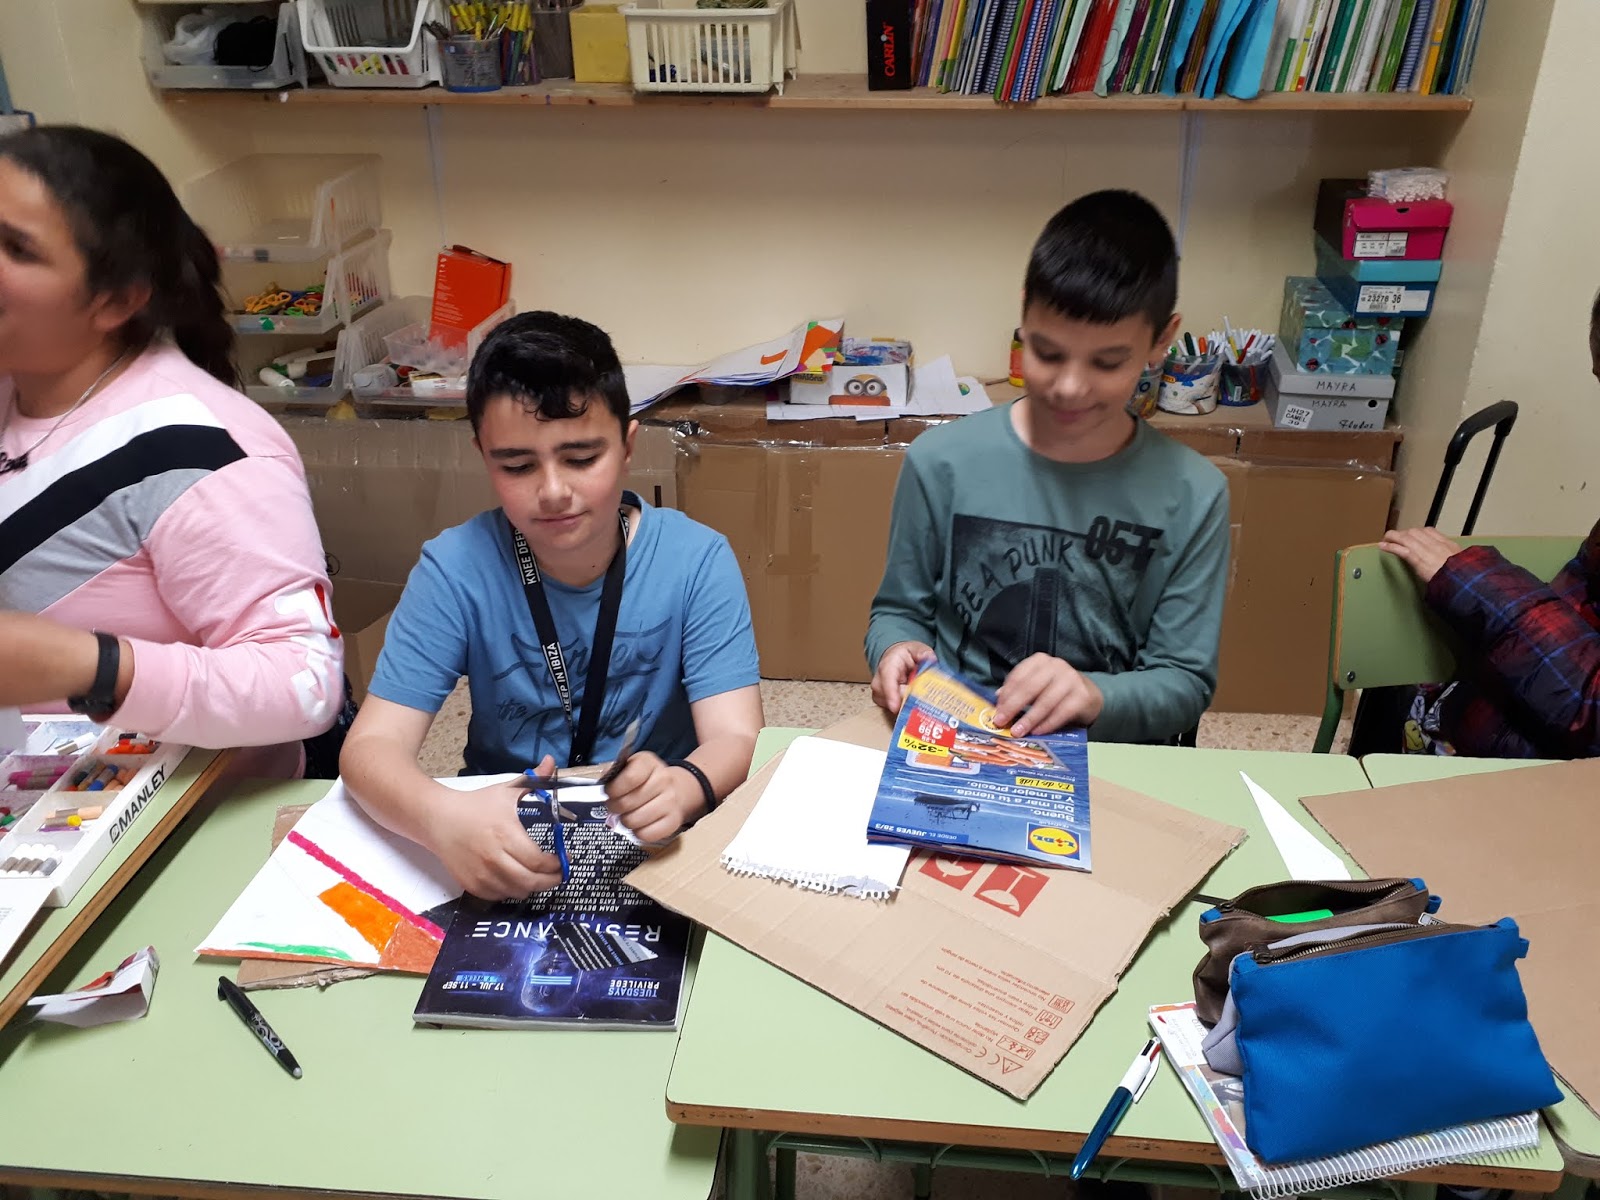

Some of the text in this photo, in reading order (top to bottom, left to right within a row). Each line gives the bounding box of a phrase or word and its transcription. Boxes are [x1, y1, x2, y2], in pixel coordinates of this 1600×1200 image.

[1391, 293, 1402, 304] 36
[1316, 381, 1357, 392] MAYRA
[1312, 400, 1348, 408] MAYRA
[979, 561, 1003, 590] A
[1003, 533, 1075, 580] PUNK
[520, 555, 537, 585] KNEE
[545, 642, 573, 711] DEEP IN IBIZA
[952, 787, 994, 800] tienda.
[966, 779, 1074, 803] Y al mejor precio.
[118, 766, 167, 833] MANLEY
[996, 794, 1011, 802] tu
[1024, 797, 1049, 808] mar
[1052, 802, 1074, 812] Del
[1028, 808, 1075, 822] Bueno.
[895, 826, 927, 837] JUEVES
[549, 912, 594, 920] IBIZA
[441, 980, 469, 990] 11.SEP
[477, 981, 504, 990] 17.JUL
[609, 979, 659, 989] PRIVILEGE
[607, 987, 657, 997] TUESDAYS
